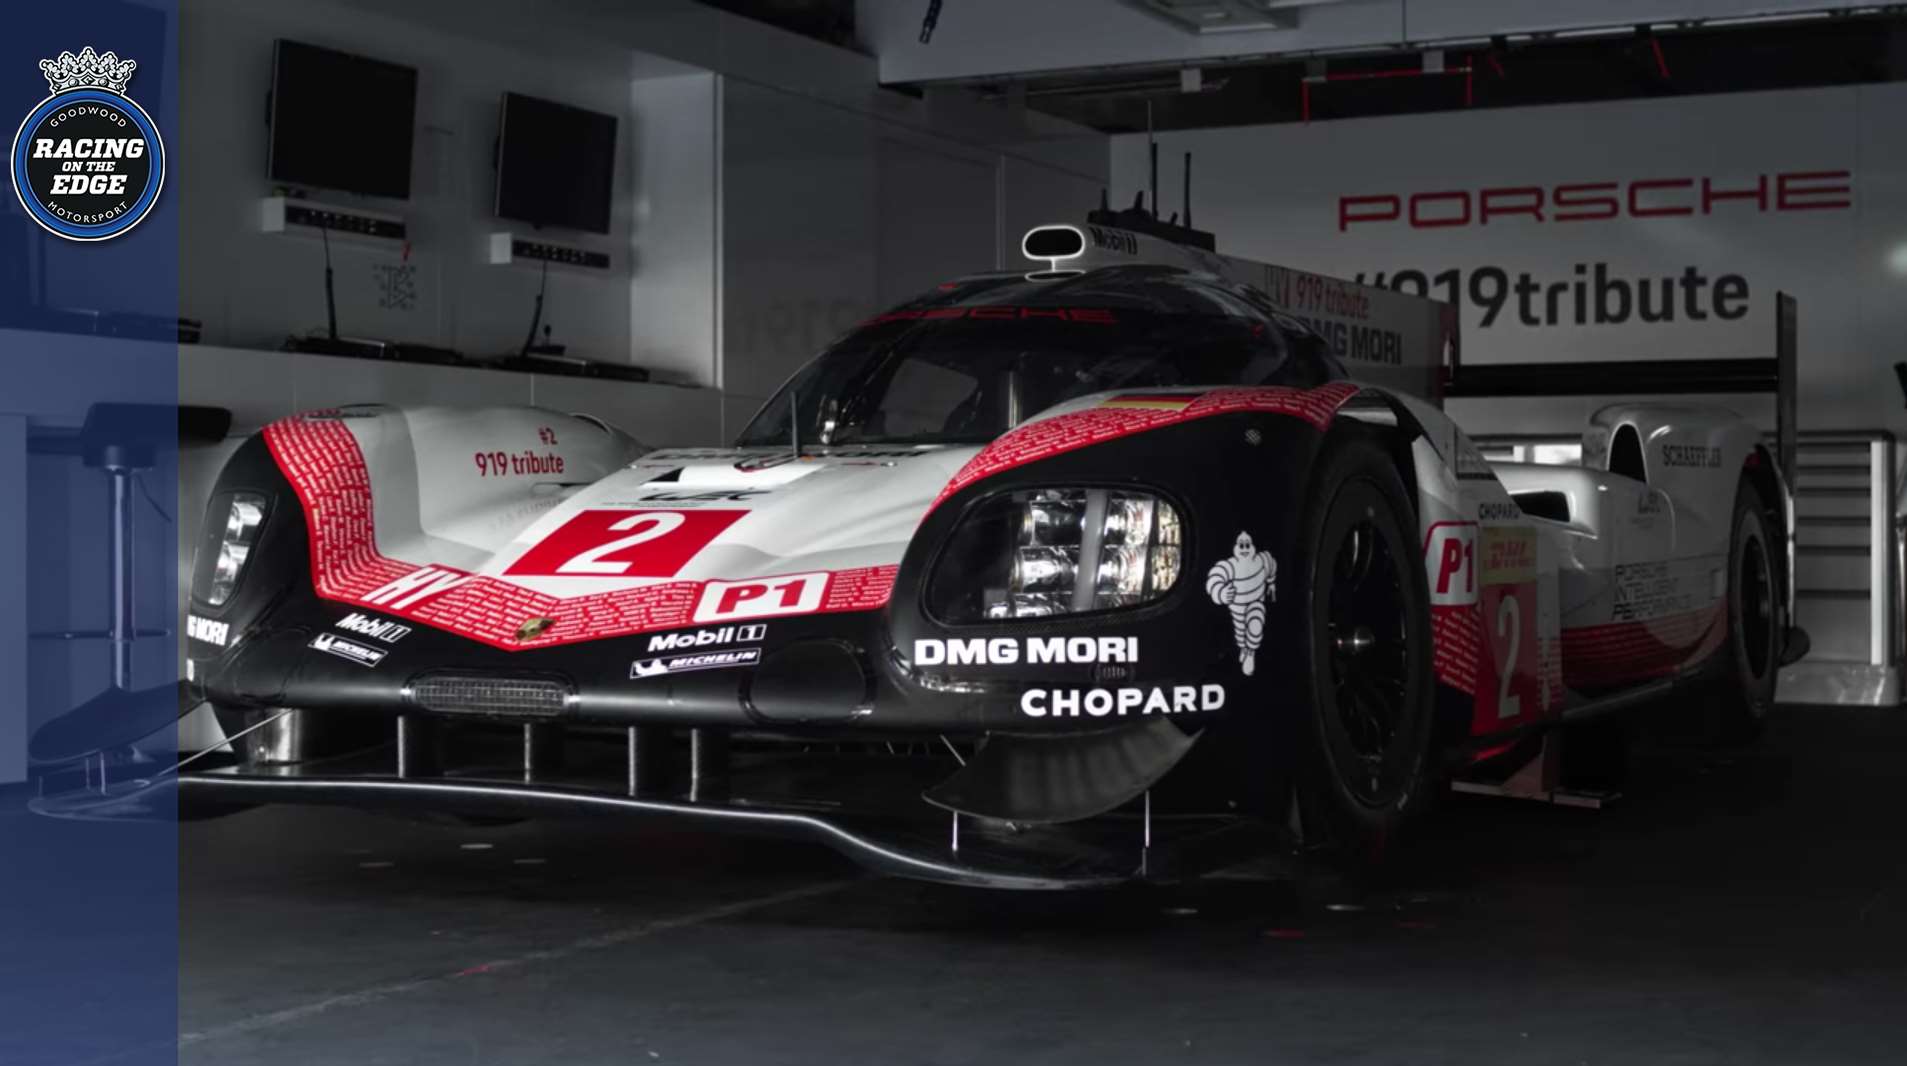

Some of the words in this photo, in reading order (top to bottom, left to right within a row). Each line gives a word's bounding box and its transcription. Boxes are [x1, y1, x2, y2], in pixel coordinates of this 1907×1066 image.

[1339, 170, 1851, 232] PORSCHE
[1295, 273, 1324, 310] 919
[1325, 283, 1369, 320] tribute
[1355, 263, 1750, 328] 19tribute
[1351, 324, 1402, 365] MORI
[538, 427, 558, 446] #2
[475, 451, 508, 477] 919
[511, 450, 565, 475] tribute
[1478, 502, 1521, 521] CHOPARD
[555, 511, 687, 575] 2
[1436, 537, 1475, 594] P1
[715, 579, 807, 614] P1
[196, 616, 229, 646] MORI
[334, 612, 394, 637] Mobil
[647, 627, 735, 652] Mobil
[669, 651, 757, 667] MICHELIN
[913, 637, 1020, 666] DMG
[1026, 636, 1139, 664] MORI
[1497, 594, 1522, 720] 2
[1020, 683, 1226, 717] CHOPARD
